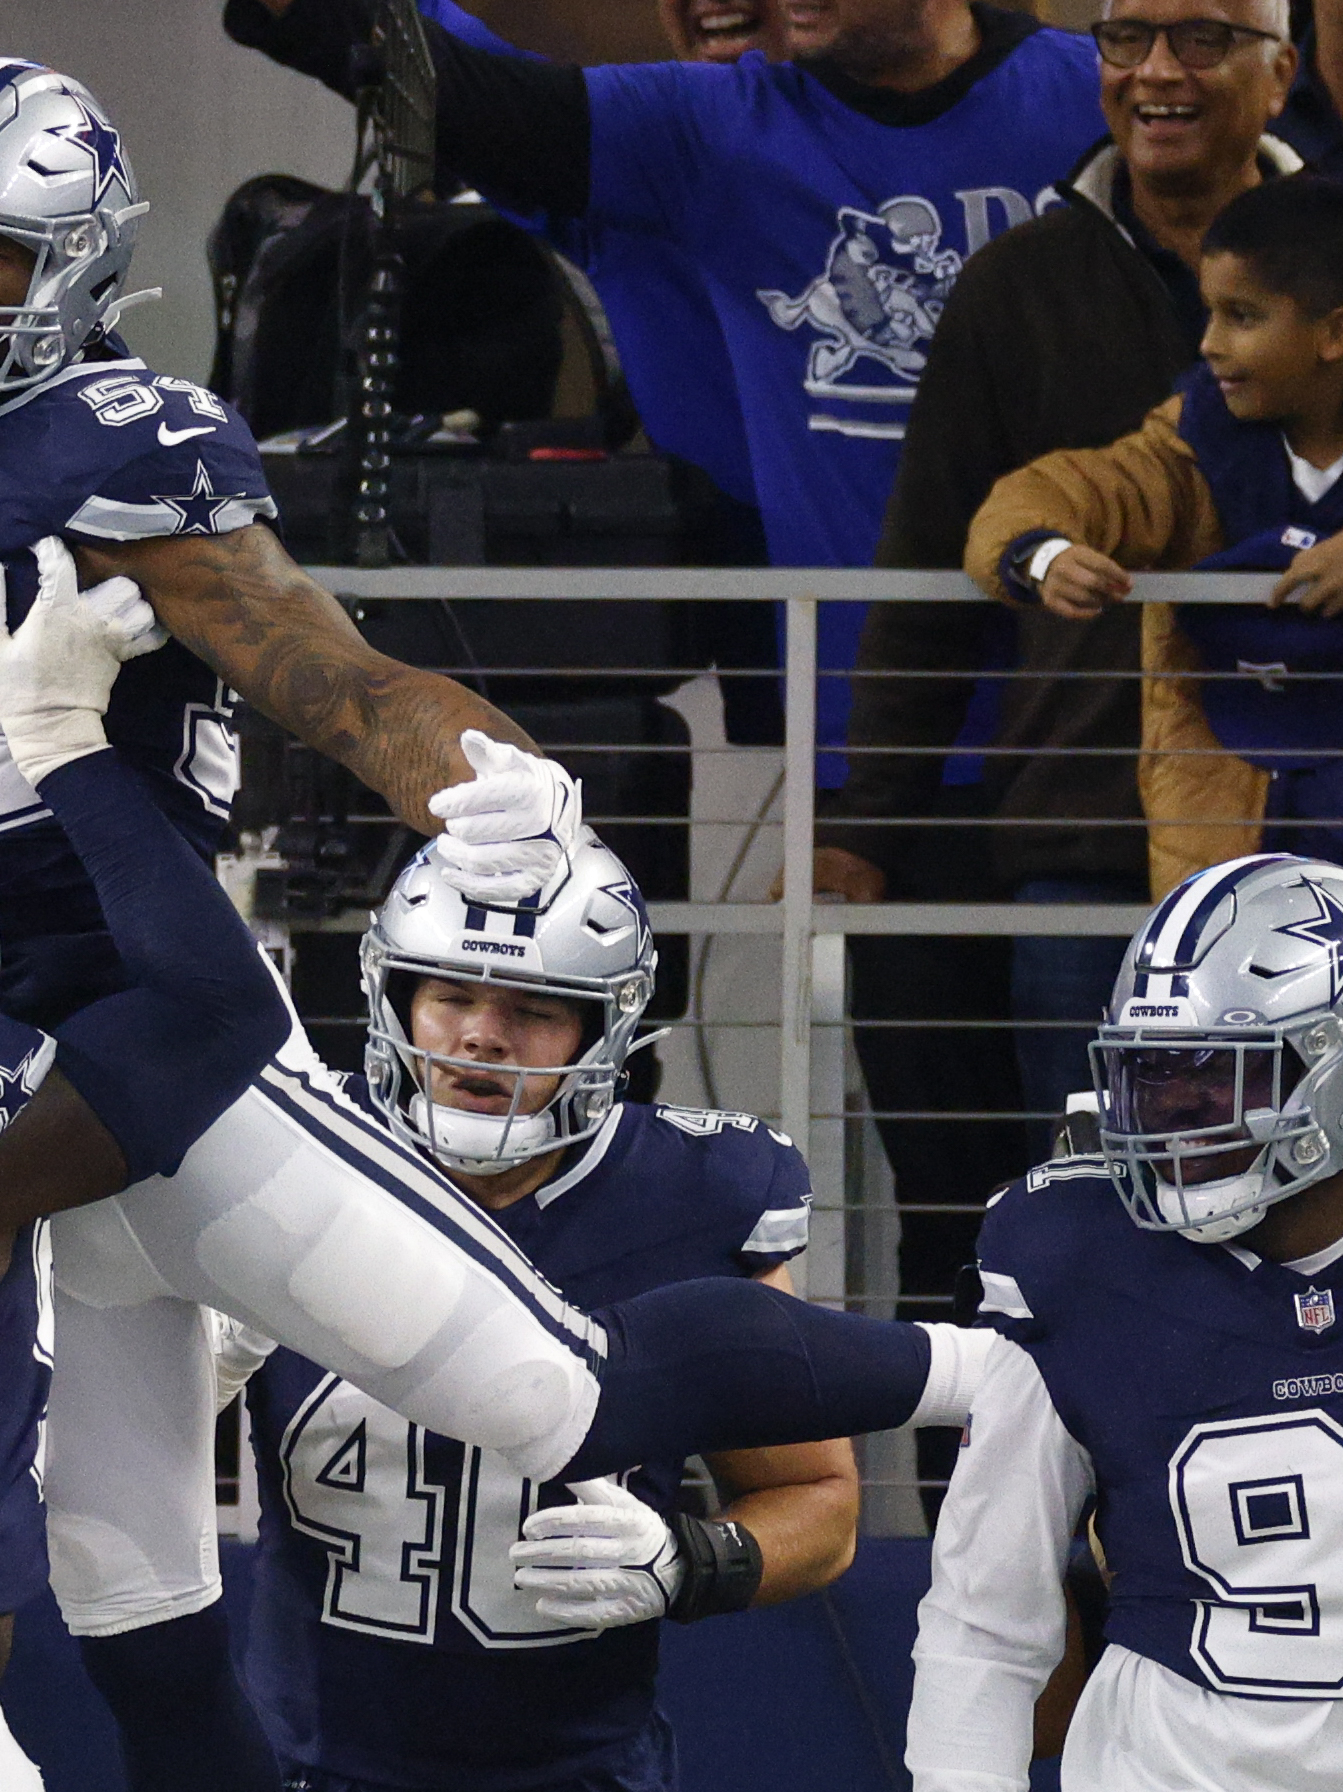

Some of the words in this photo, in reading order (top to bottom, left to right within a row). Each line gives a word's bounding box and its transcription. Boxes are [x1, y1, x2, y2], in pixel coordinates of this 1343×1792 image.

[77, 375, 228, 426] 54
[461, 939, 526, 957] COWBOYS
[1129, 1005, 1179, 1018] COWBOYS
[654, 1101, 759, 1137] 4
